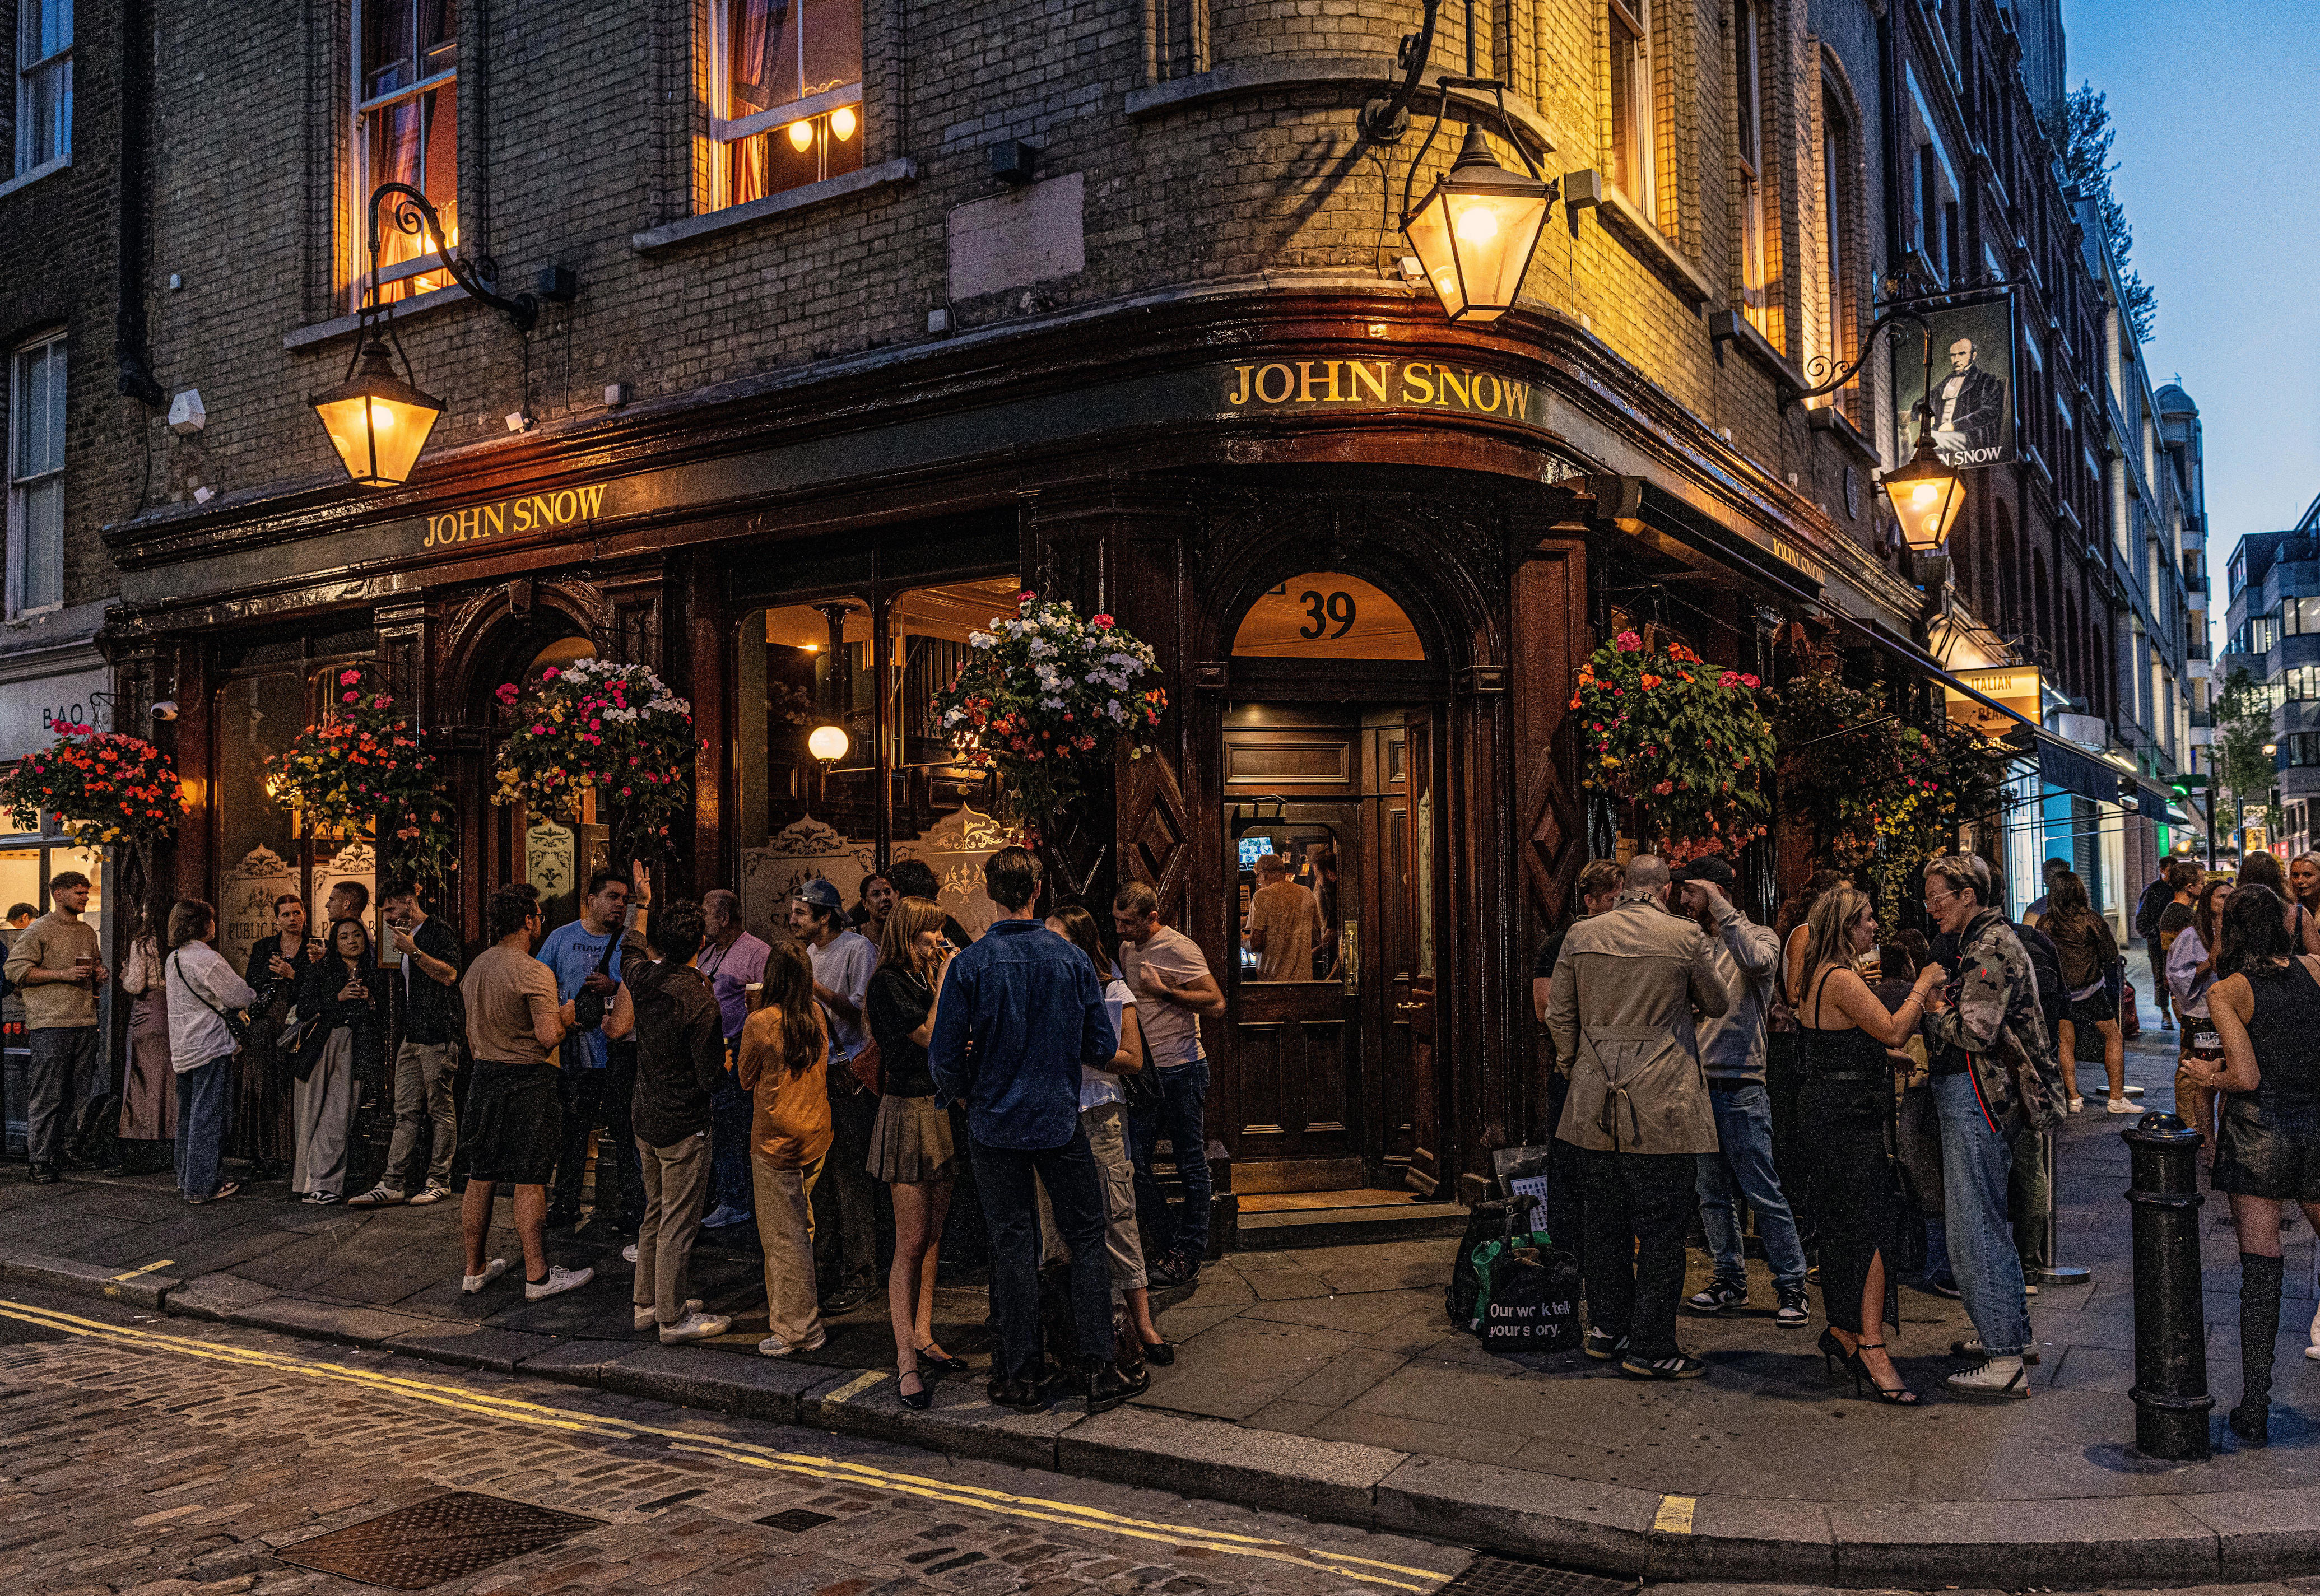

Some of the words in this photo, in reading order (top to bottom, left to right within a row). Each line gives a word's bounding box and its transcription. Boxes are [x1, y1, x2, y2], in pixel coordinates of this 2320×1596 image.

[1229, 360, 1391, 405] JOHN
[1402, 362, 1532, 420] SNOW
[1954, 446, 2003, 466] SNOW
[424, 502, 506, 547] JOHN
[513, 483, 607, 532] SNOW
[1299, 590, 1356, 640] 39
[1971, 675, 2012, 692] ITALIAN
[43, 703, 83, 729] BAO
[229, 923, 268, 940] PUBLIC
[1490, 1303, 1513, 1318] Our
[1516, 1302, 1551, 1317] wok
[1552, 1300, 1570, 1315] tell
[1488, 1325, 1520, 1338] your
[1523, 1323, 1561, 1338] sory.
